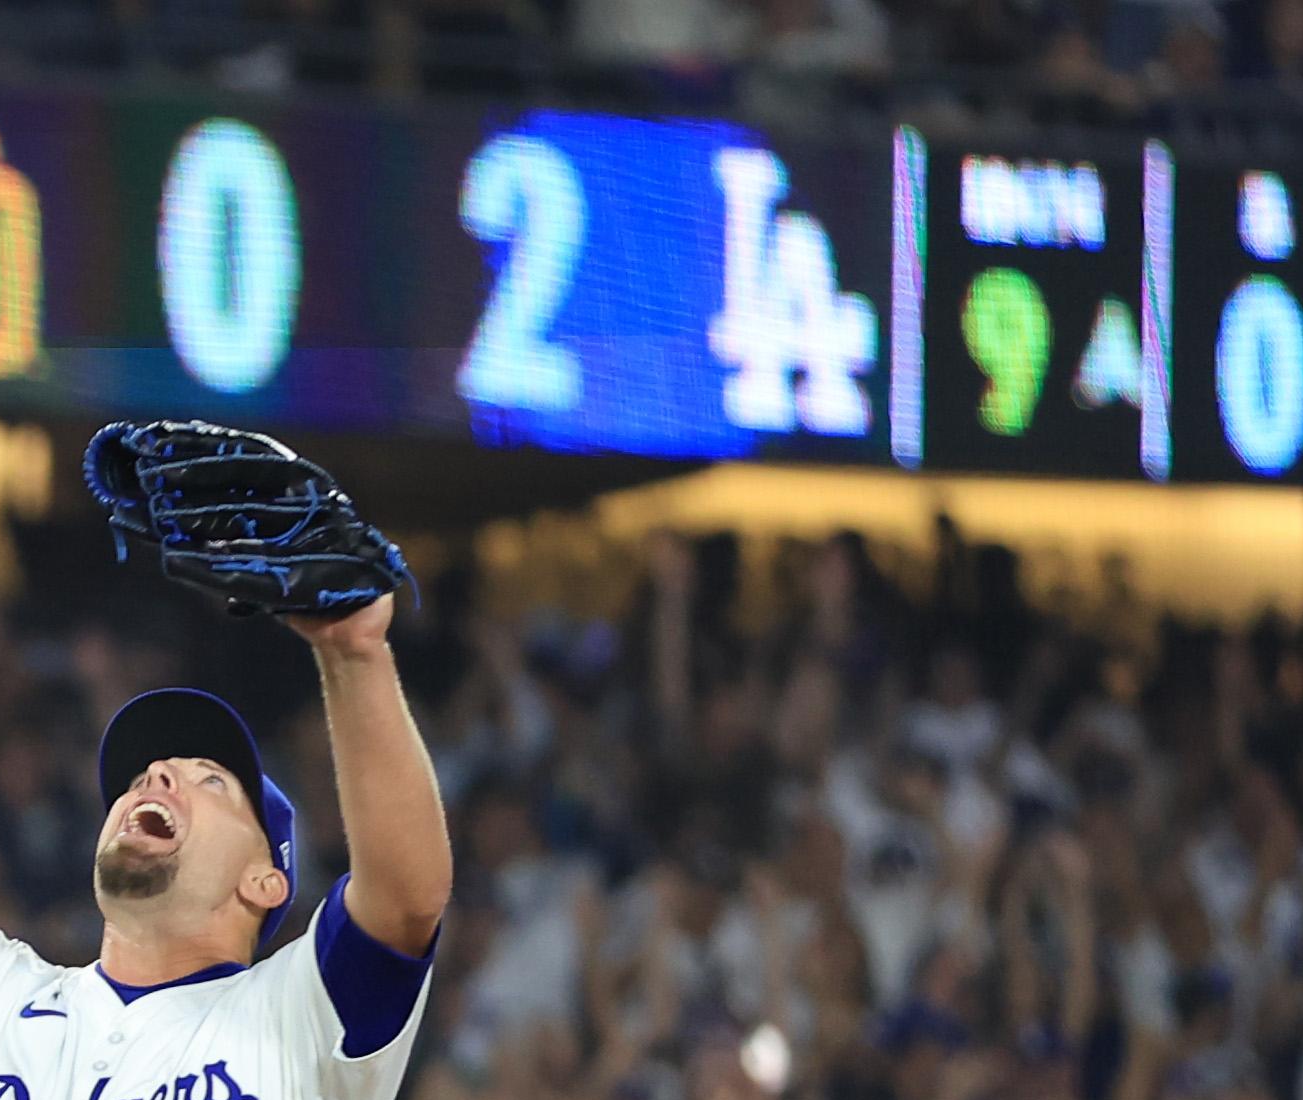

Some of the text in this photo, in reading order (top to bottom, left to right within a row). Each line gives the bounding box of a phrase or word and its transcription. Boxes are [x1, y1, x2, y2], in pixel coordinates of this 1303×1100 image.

[158, 118, 300, 392] 0
[459, 134, 584, 409] 2
[709, 147, 877, 437] LA
[961, 267, 1052, 437] 9
